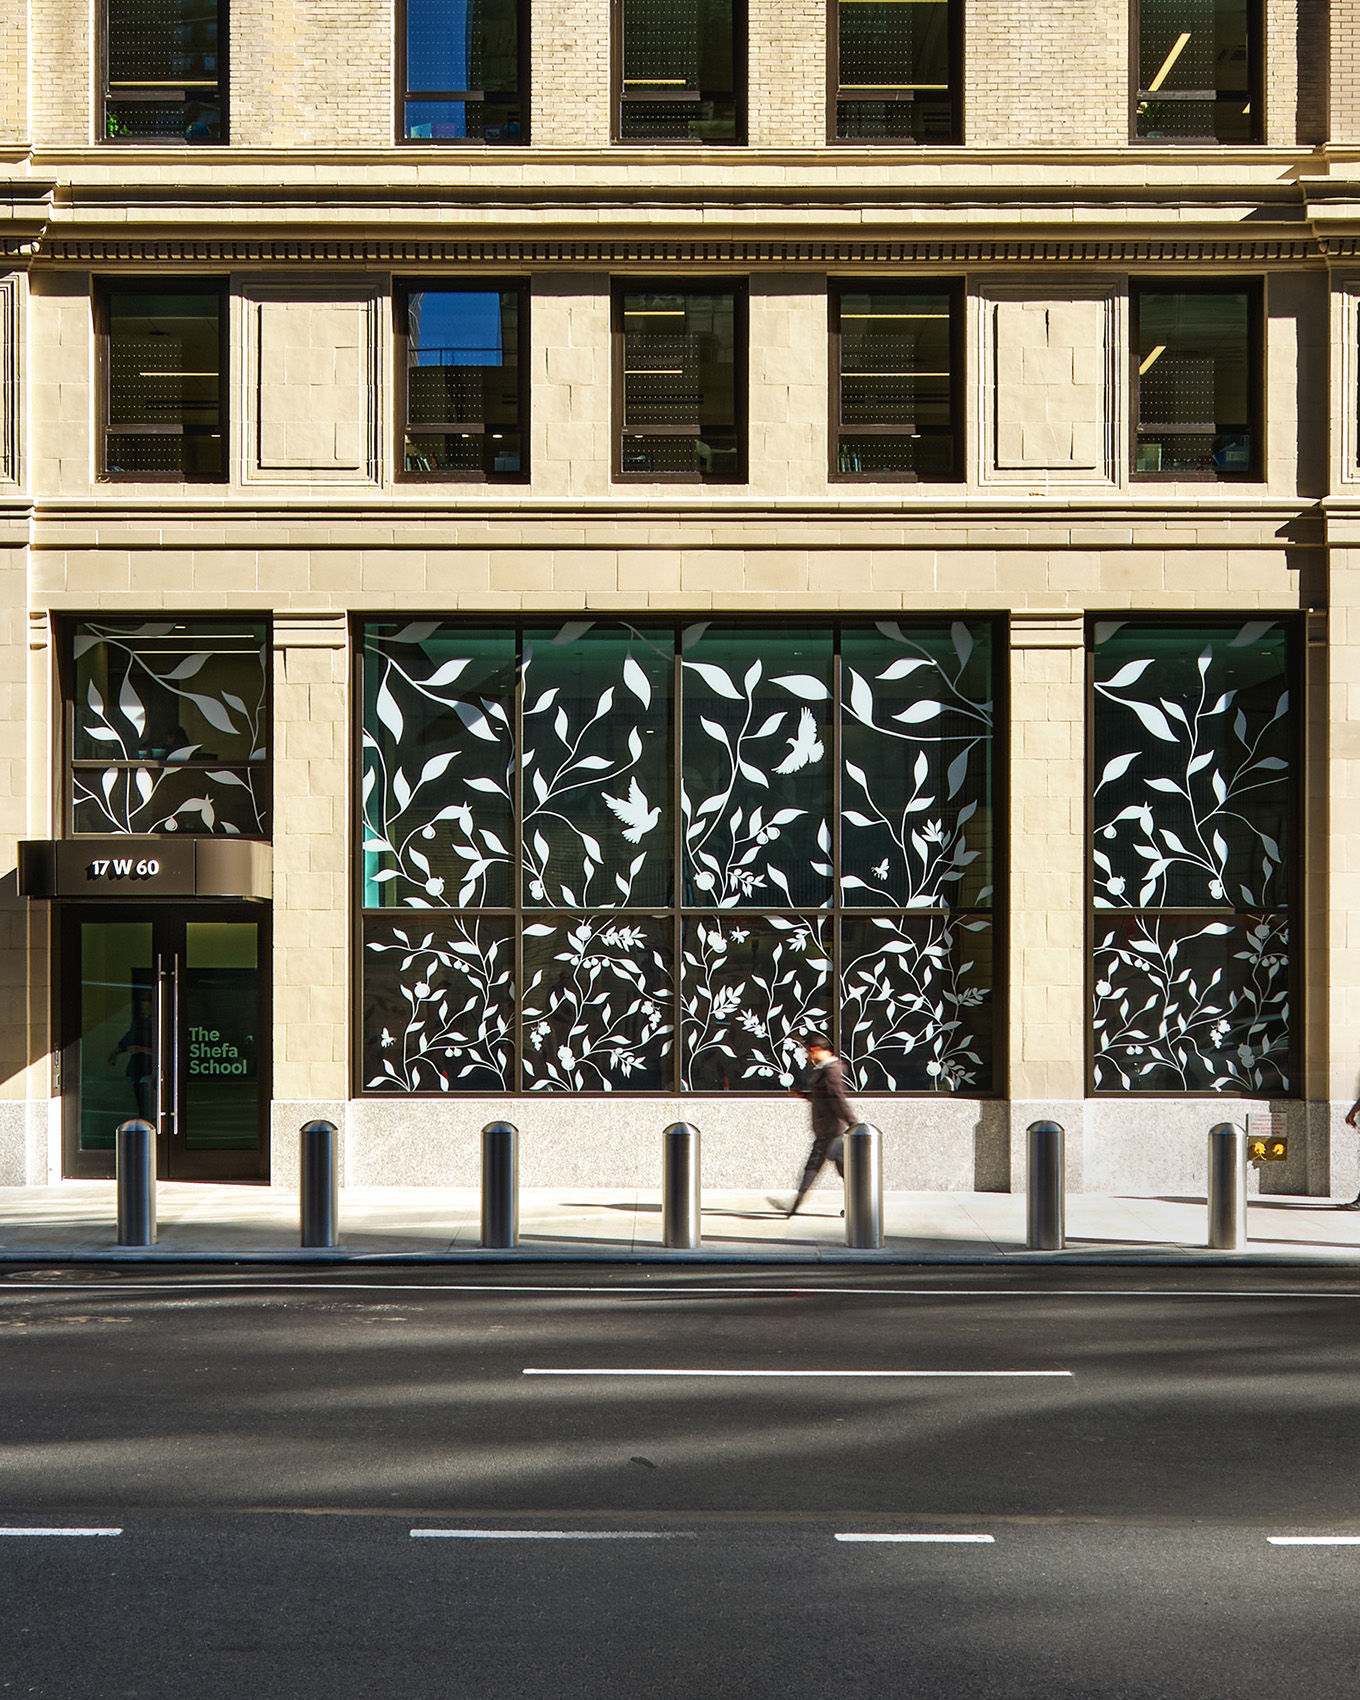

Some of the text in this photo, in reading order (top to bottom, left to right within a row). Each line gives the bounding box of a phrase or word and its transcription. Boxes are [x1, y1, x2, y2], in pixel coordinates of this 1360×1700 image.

[92, 859, 160, 876] 17 W 60
[188, 1026, 220, 1041] The
[189, 1043, 239, 1058] Shefa
[189, 1059, 247, 1074] School
